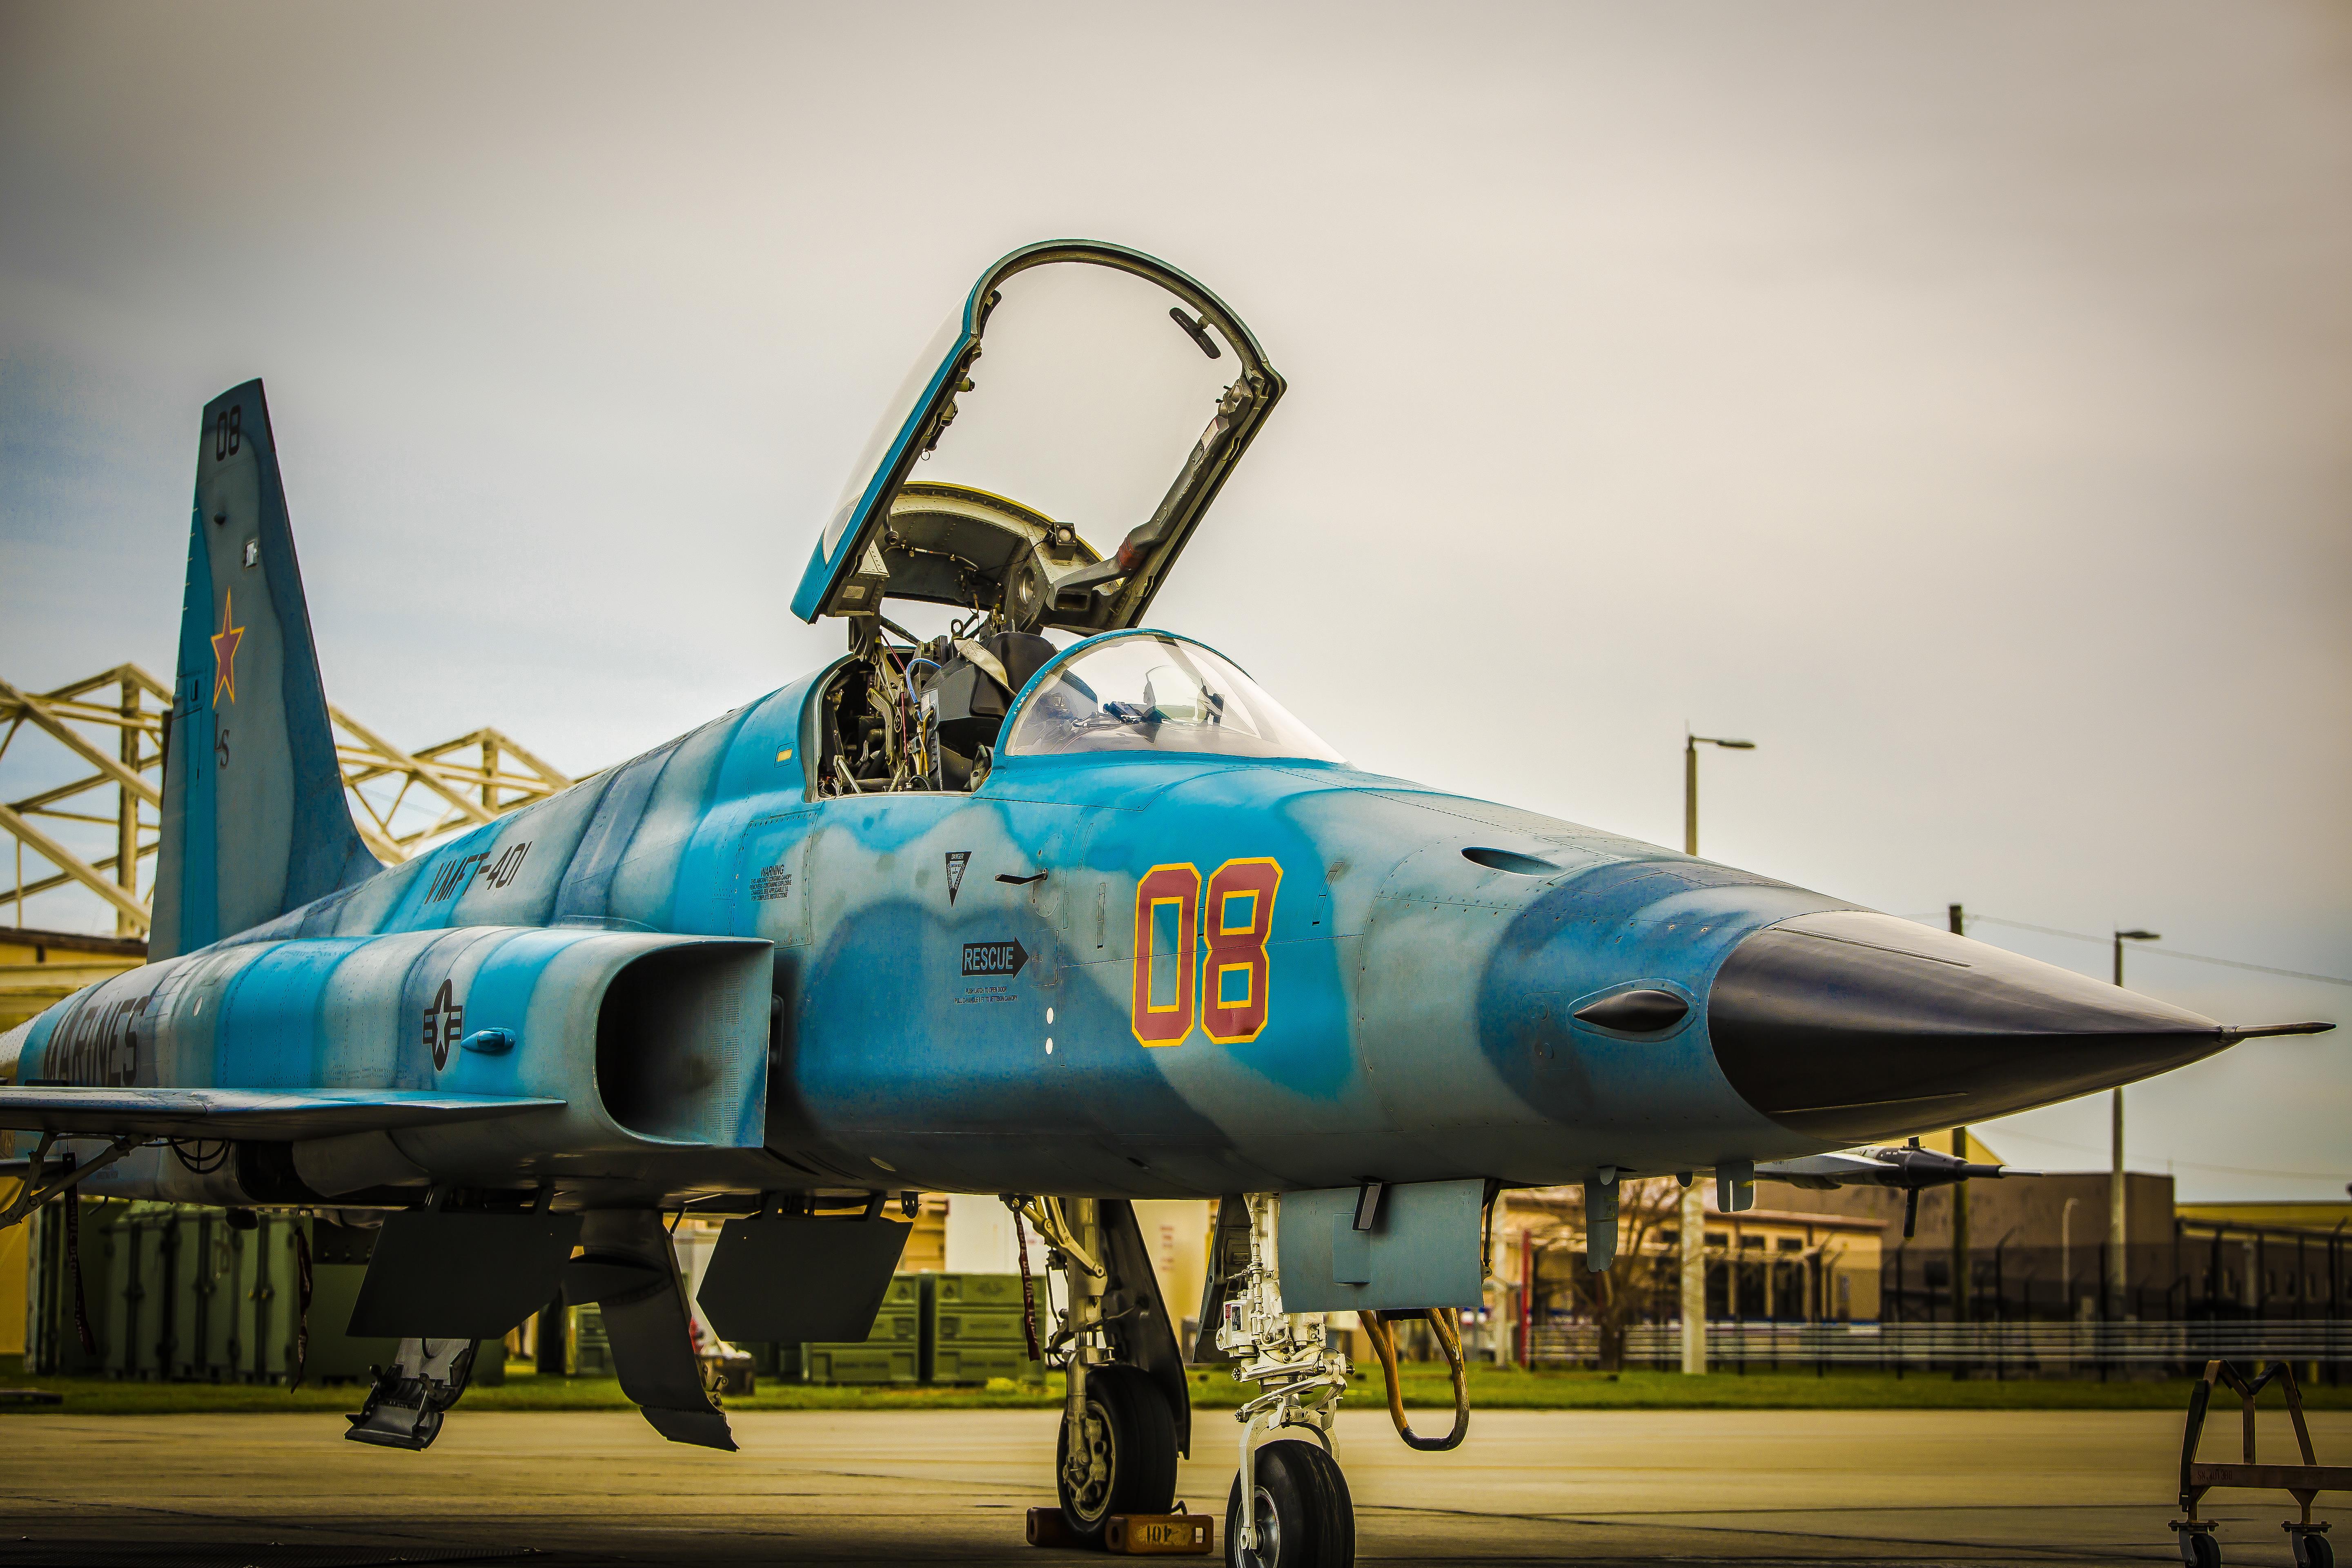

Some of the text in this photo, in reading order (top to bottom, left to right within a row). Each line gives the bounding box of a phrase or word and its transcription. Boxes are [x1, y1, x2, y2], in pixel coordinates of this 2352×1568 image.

[216, 404, 241, 462] 08
[424, 841, 532, 905] VMFT-401
[761, 864, 784, 878] WARNING
[954, 863, 965, 890] DANGER
[964, 947, 1013, 970] RESCUE
[1131, 856, 1283, 1048] 08
[42, 995, 151, 1087] MARINES
